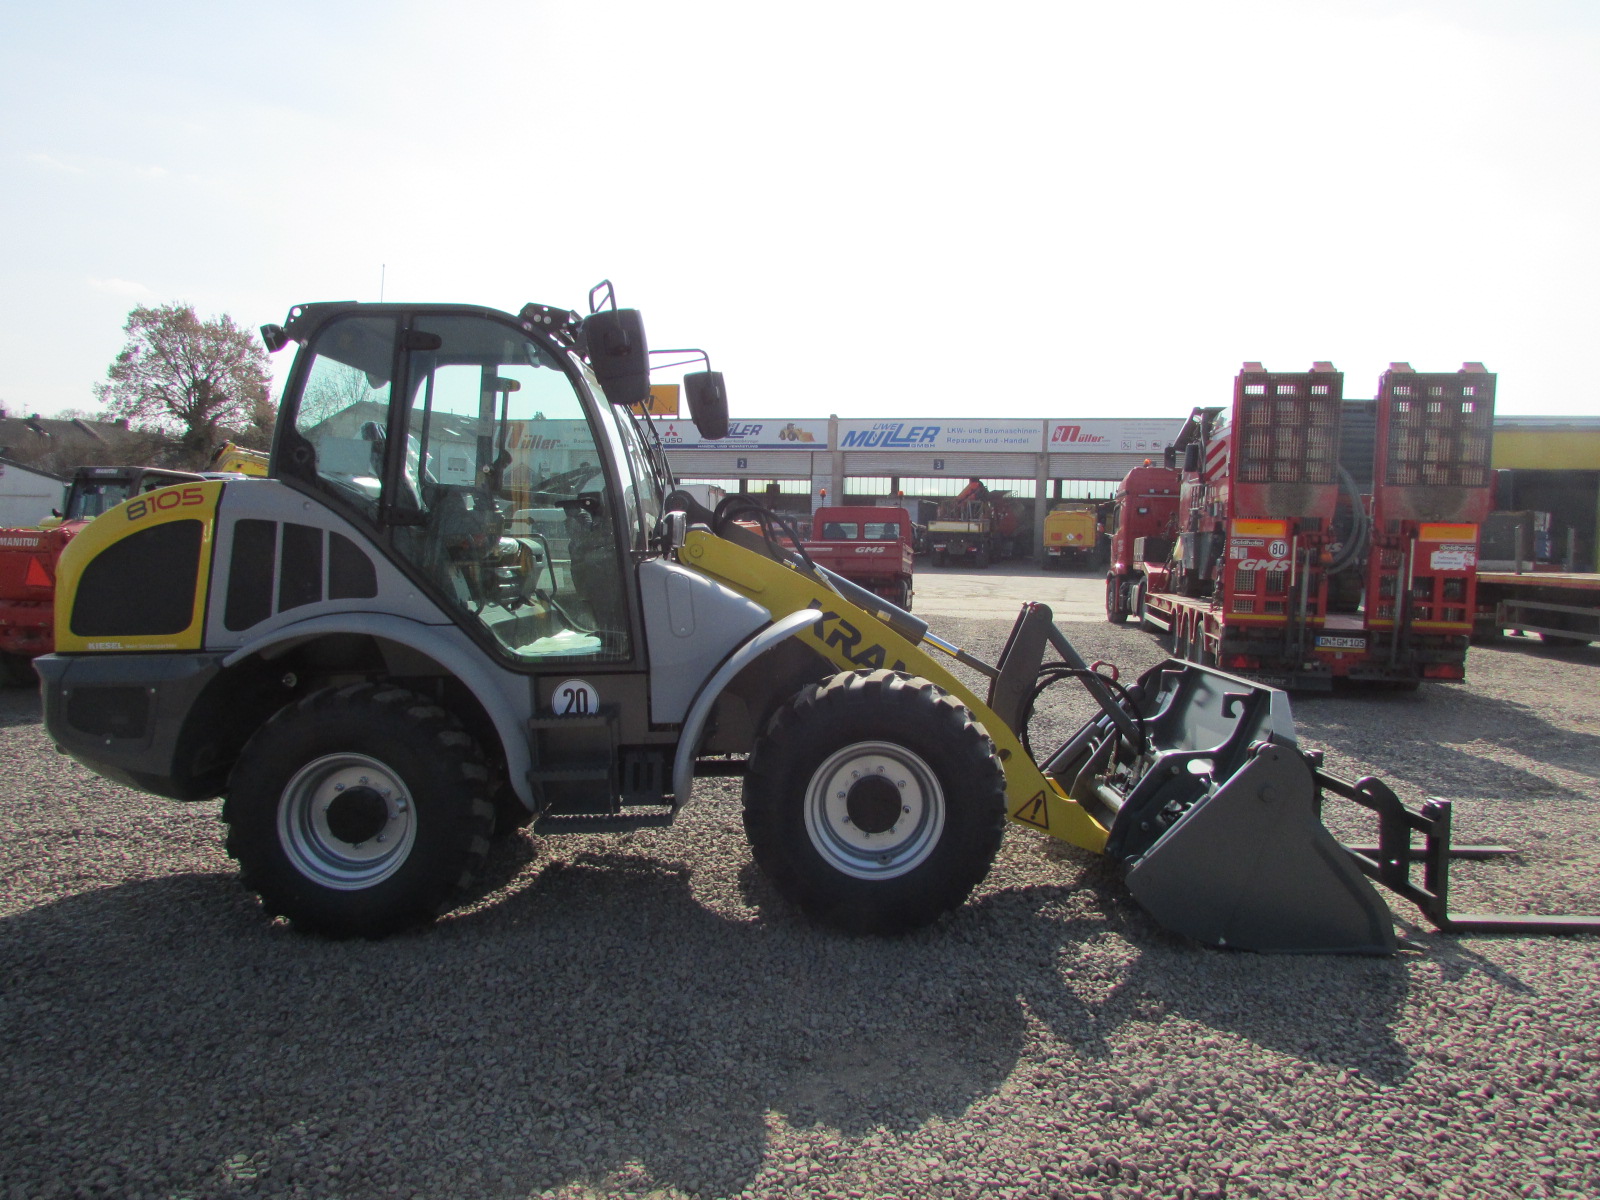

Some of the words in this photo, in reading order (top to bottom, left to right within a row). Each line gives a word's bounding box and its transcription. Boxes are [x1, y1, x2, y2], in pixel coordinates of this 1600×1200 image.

[872, 423, 898, 431] UWE
[841, 423, 941, 448] MÜLLER
[946, 437, 982, 445] Reparatur
[127, 487, 205, 520] 8105
[0, 537, 39, 547] MANITOU
[1272, 543, 1285, 555] 80
[1237, 559, 1291, 571] GMS
[806, 598, 906, 672] KRA
[88, 642, 124, 650] KIESEL
[1348, 639, 1365, 648] 105
[563, 688, 588, 714] 20
